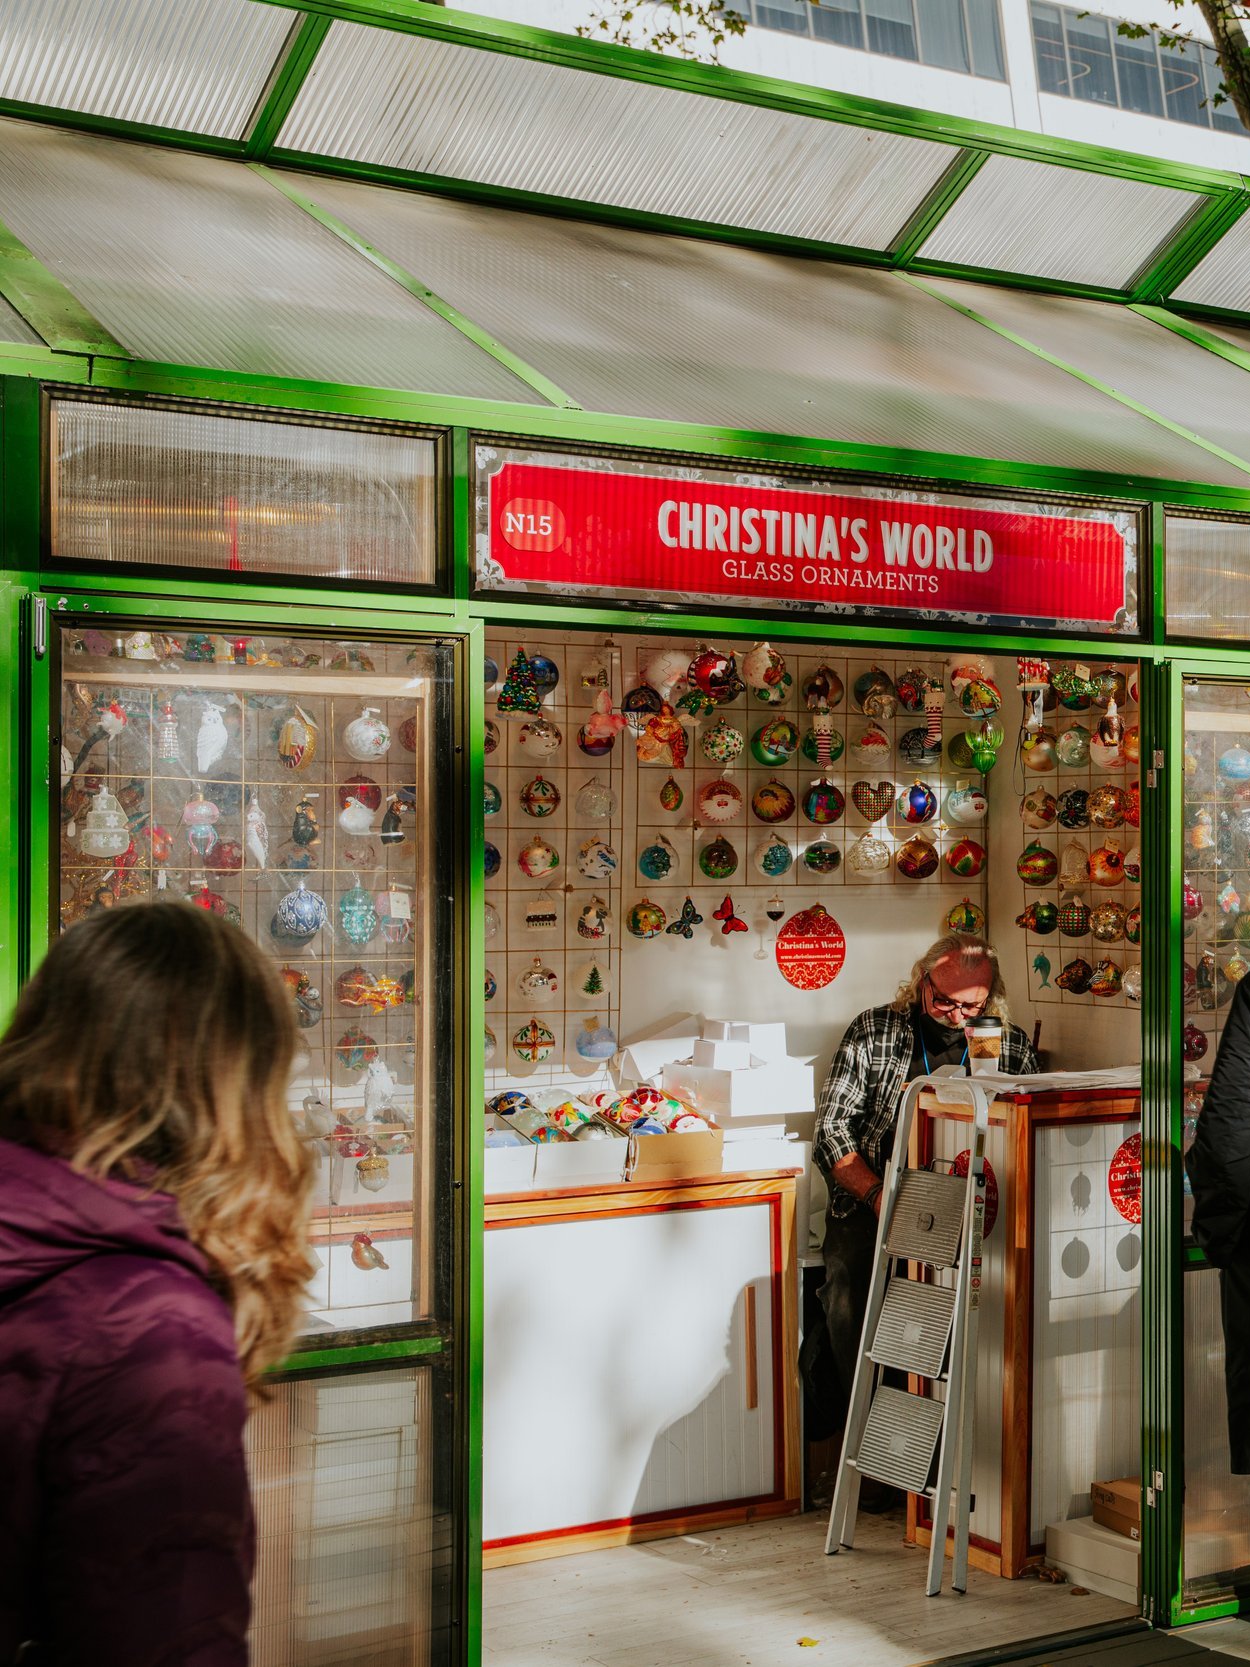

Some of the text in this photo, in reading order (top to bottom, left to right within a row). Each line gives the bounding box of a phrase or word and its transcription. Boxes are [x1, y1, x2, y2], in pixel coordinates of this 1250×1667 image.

[505, 512, 552, 535] N15
[656, 499, 994, 573] CHRISTINA'S WORLD
[721, 558, 940, 594] GLASS ORNAMENTS
[778, 940, 844, 950] Christina's World
